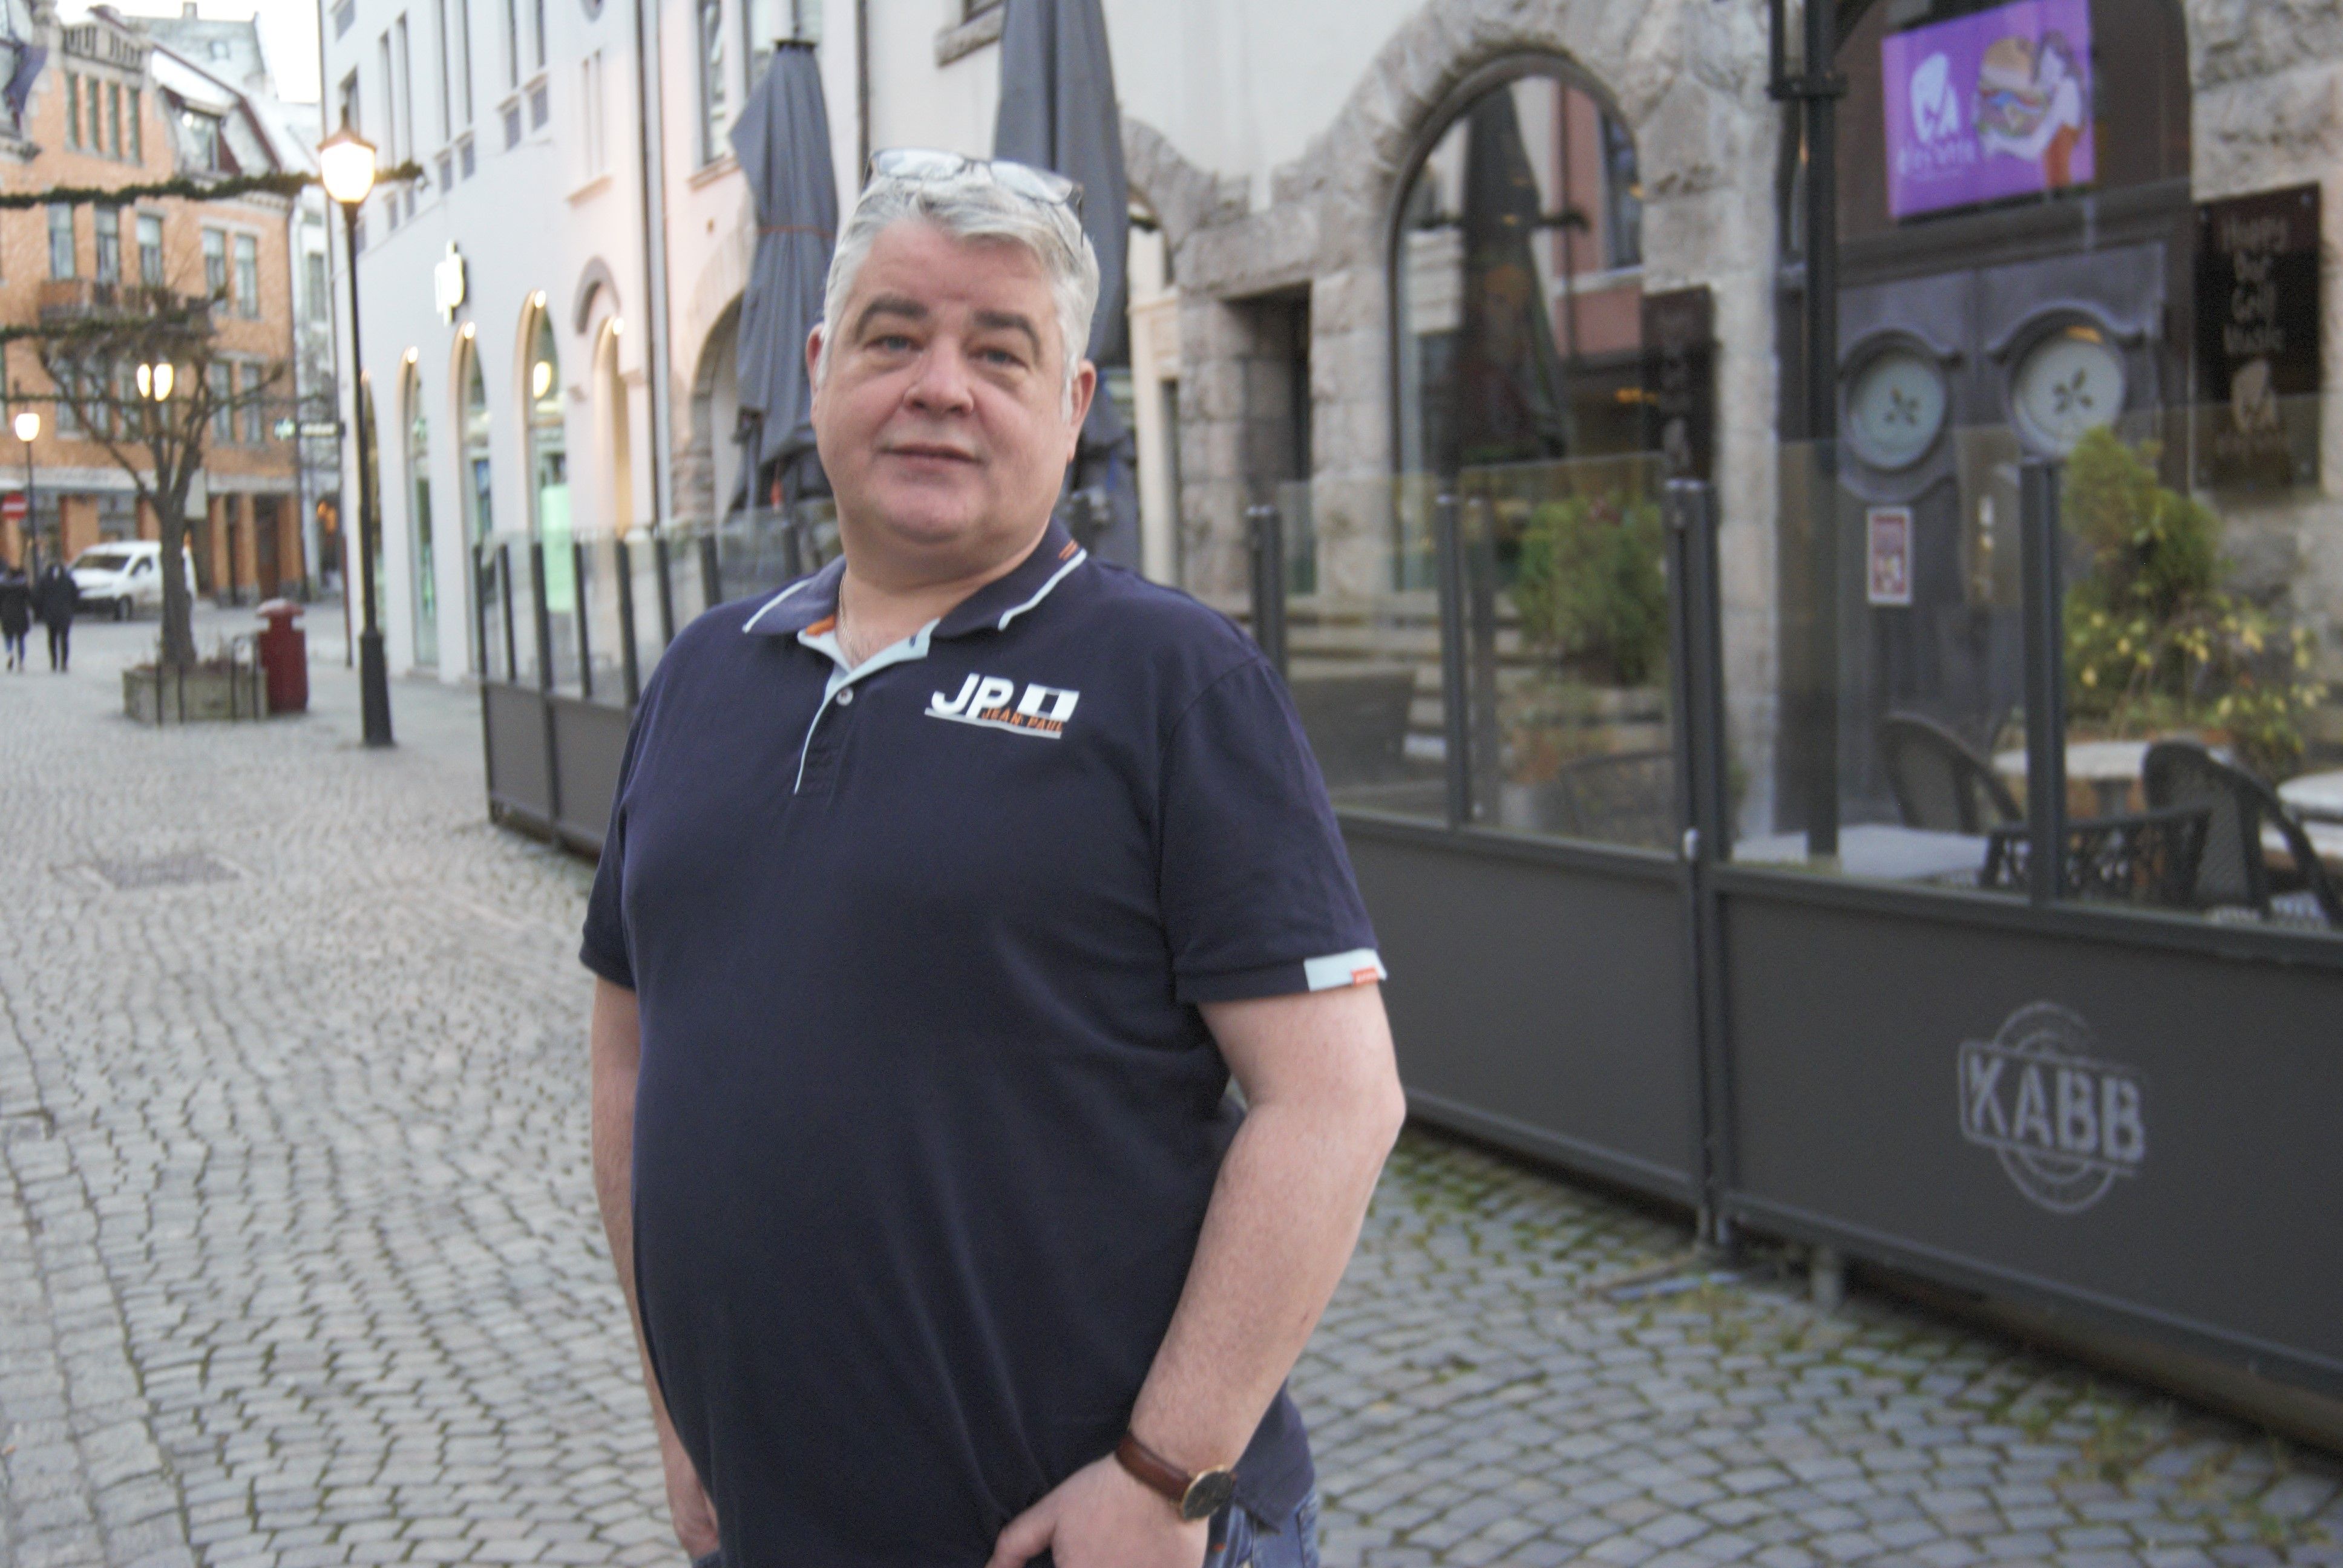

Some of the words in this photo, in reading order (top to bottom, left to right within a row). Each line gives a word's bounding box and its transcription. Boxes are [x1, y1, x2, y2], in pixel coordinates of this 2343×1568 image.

[931, 673, 1014, 720] JP
[981, 707, 1024, 726] JEAN
[1969, 1054, 2145, 1163] KABB
